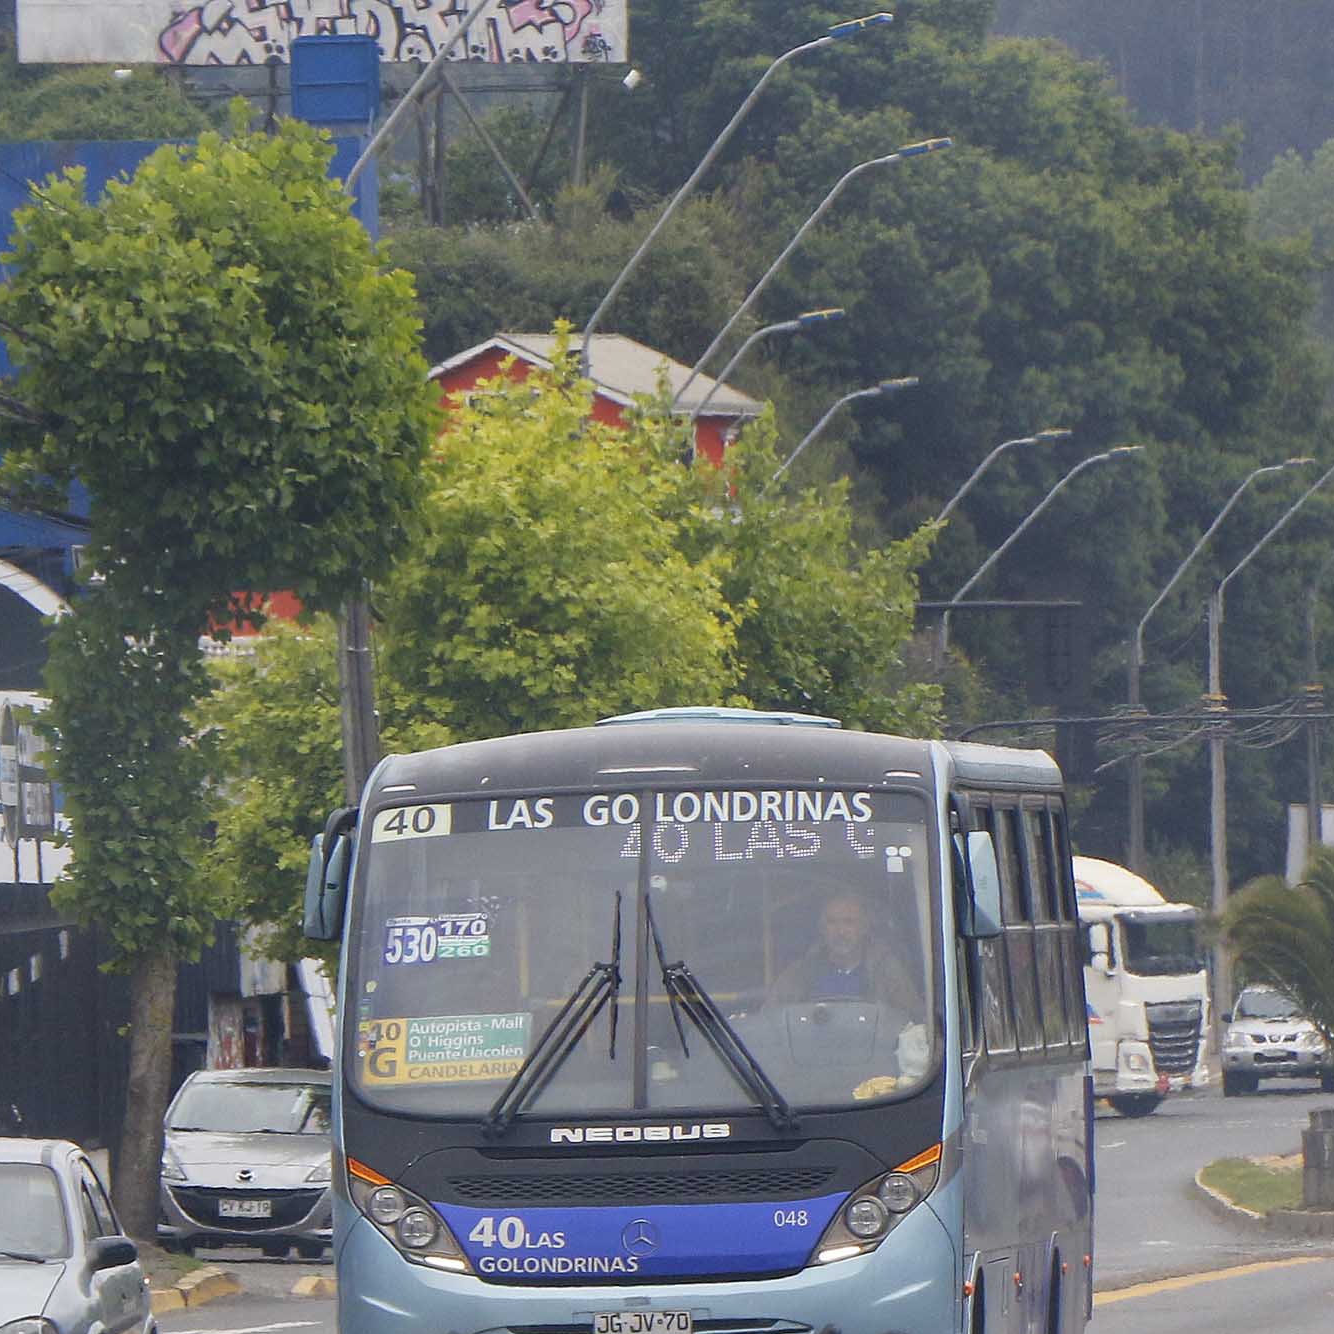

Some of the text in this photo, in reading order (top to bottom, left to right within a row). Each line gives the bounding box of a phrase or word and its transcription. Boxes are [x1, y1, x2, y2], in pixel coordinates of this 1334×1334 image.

[383, 805, 437, 836] 40
[487, 798, 555, 830] LAS
[714, 819, 821, 862] LAS
[440, 919, 487, 936] 170
[385, 926, 437, 964] 530
[439, 944, 488, 958] 260
[369, 1021, 402, 1044] 40
[410, 1018, 482, 1036] Autopista
[490, 1015, 524, 1031] Mall
[368, 1047, 398, 1078] G
[408, 1049, 461, 1063] Puente
[408, 1060, 519, 1080] CANDELARIA
[550, 1123, 731, 1143] NEOBUS
[773, 1209, 809, 1228] 048
[468, 1216, 565, 1250] 40 LAS
[479, 1255, 639, 1274] GOLONDRINAS
